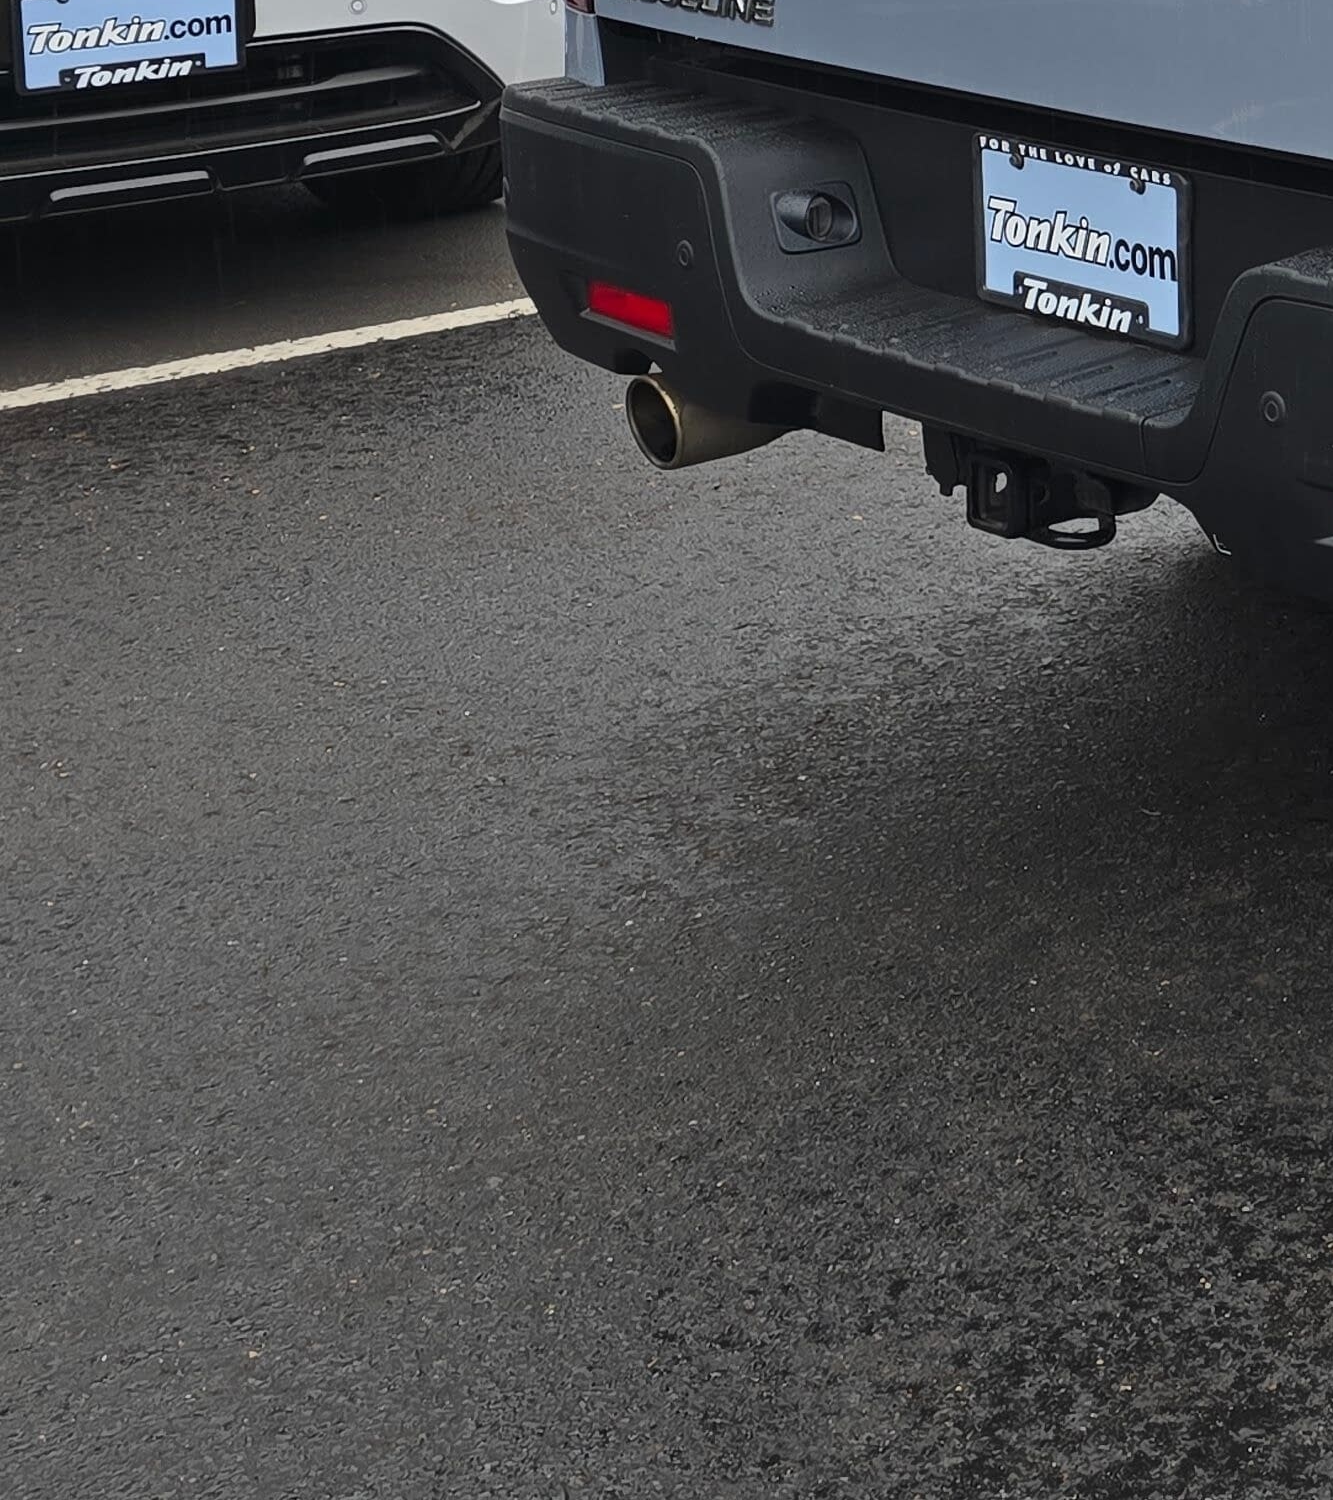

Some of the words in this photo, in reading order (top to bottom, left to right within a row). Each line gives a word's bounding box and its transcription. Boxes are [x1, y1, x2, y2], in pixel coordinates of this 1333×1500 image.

[27, 14, 232, 55] Tonkin.com
[74, 58, 193, 90] Tonkin
[979, 135, 1011, 153] FOR
[1018, 143, 1048, 161] THE
[1055, 151, 1096, 171] LOVE
[1103, 162, 1121, 177] of
[1129, 166, 1172, 186] CARS
[987, 195, 1178, 282] Tonkin.com
[1022, 277, 1132, 334] Tonkin
